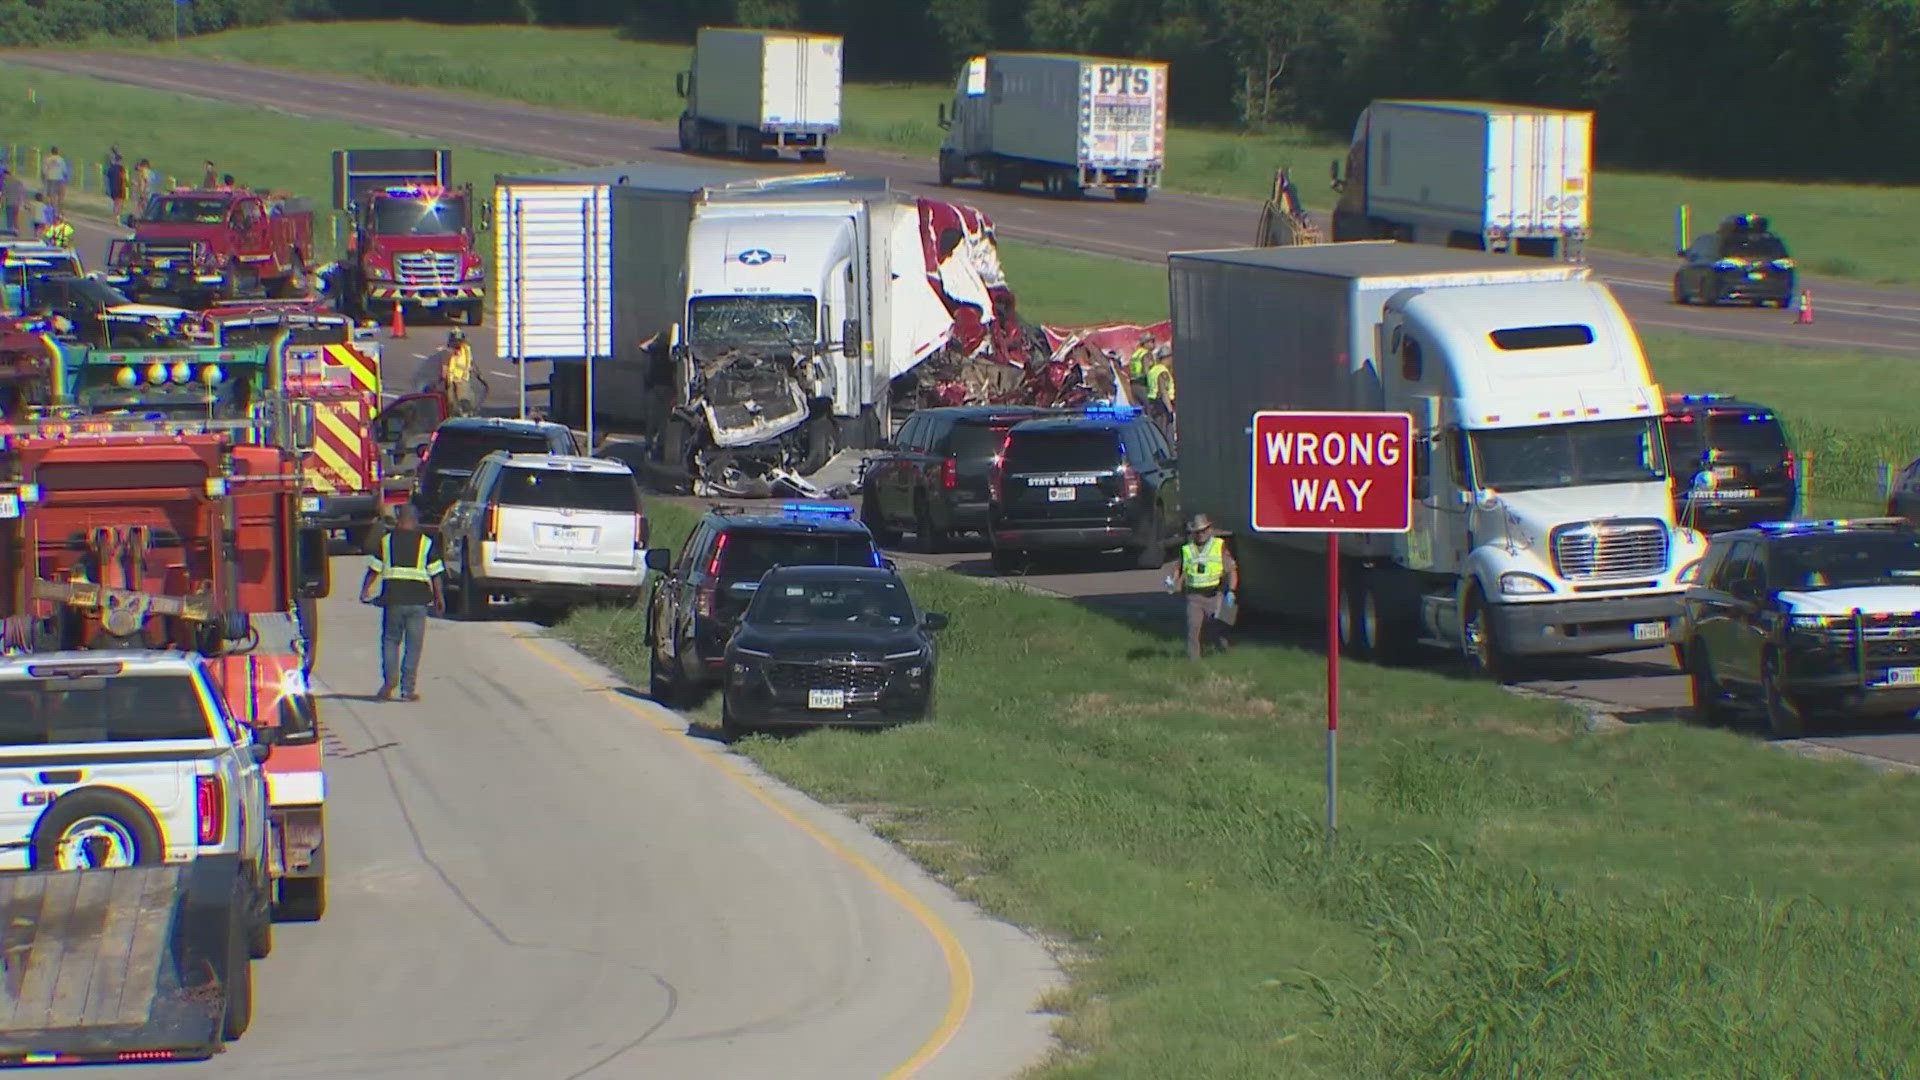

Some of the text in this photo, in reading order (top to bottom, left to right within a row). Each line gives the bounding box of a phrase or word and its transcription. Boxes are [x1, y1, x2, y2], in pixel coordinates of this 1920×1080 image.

[1099, 67, 1149, 95] PTS
[1265, 431, 1400, 466] WRONG
[1028, 476, 1097, 486] STATE TROOPER
[1291, 478, 1373, 512] WAY
